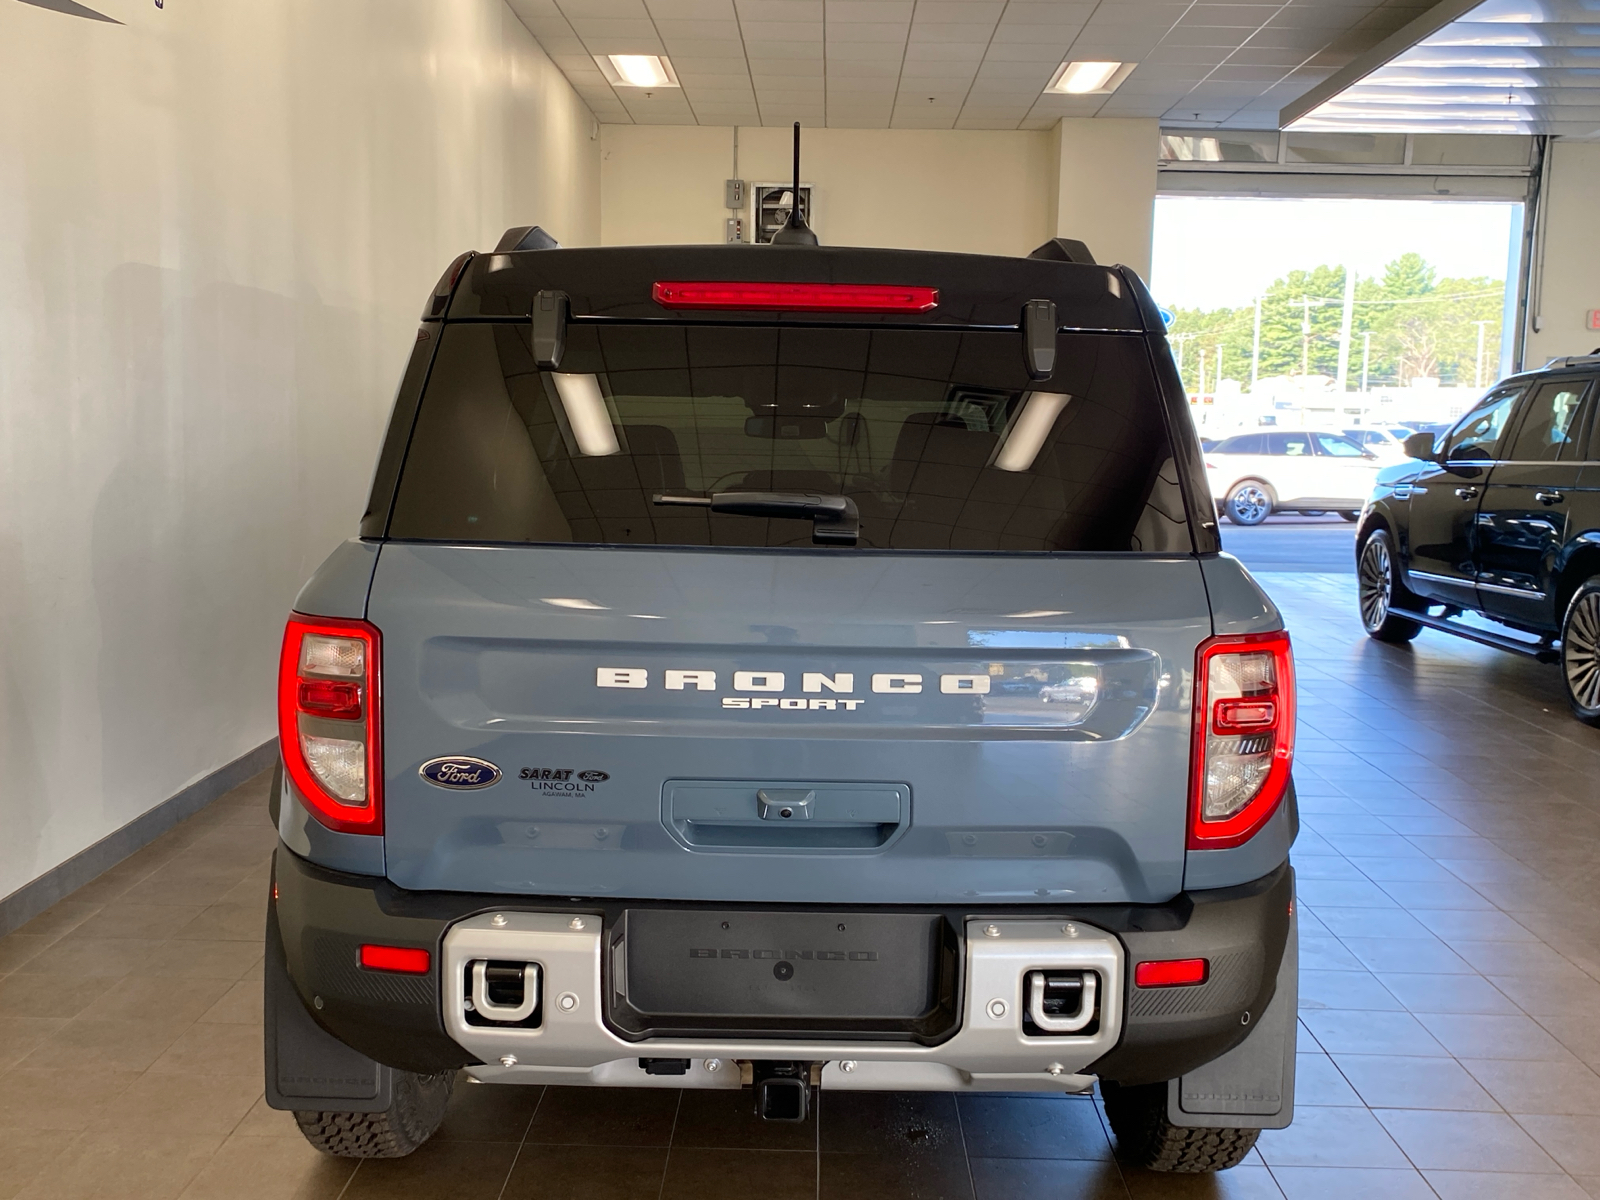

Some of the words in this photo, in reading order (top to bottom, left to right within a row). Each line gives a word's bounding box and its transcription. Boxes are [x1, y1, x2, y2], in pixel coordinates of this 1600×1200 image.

[596, 667, 991, 694] BRONCO
[721, 697, 865, 711] SPORT
[519, 767, 574, 782] SARAT
[580, 770, 606, 783] Ford
[531, 781, 595, 792] LINCOLN
[690, 948, 879, 962] BRONCO
